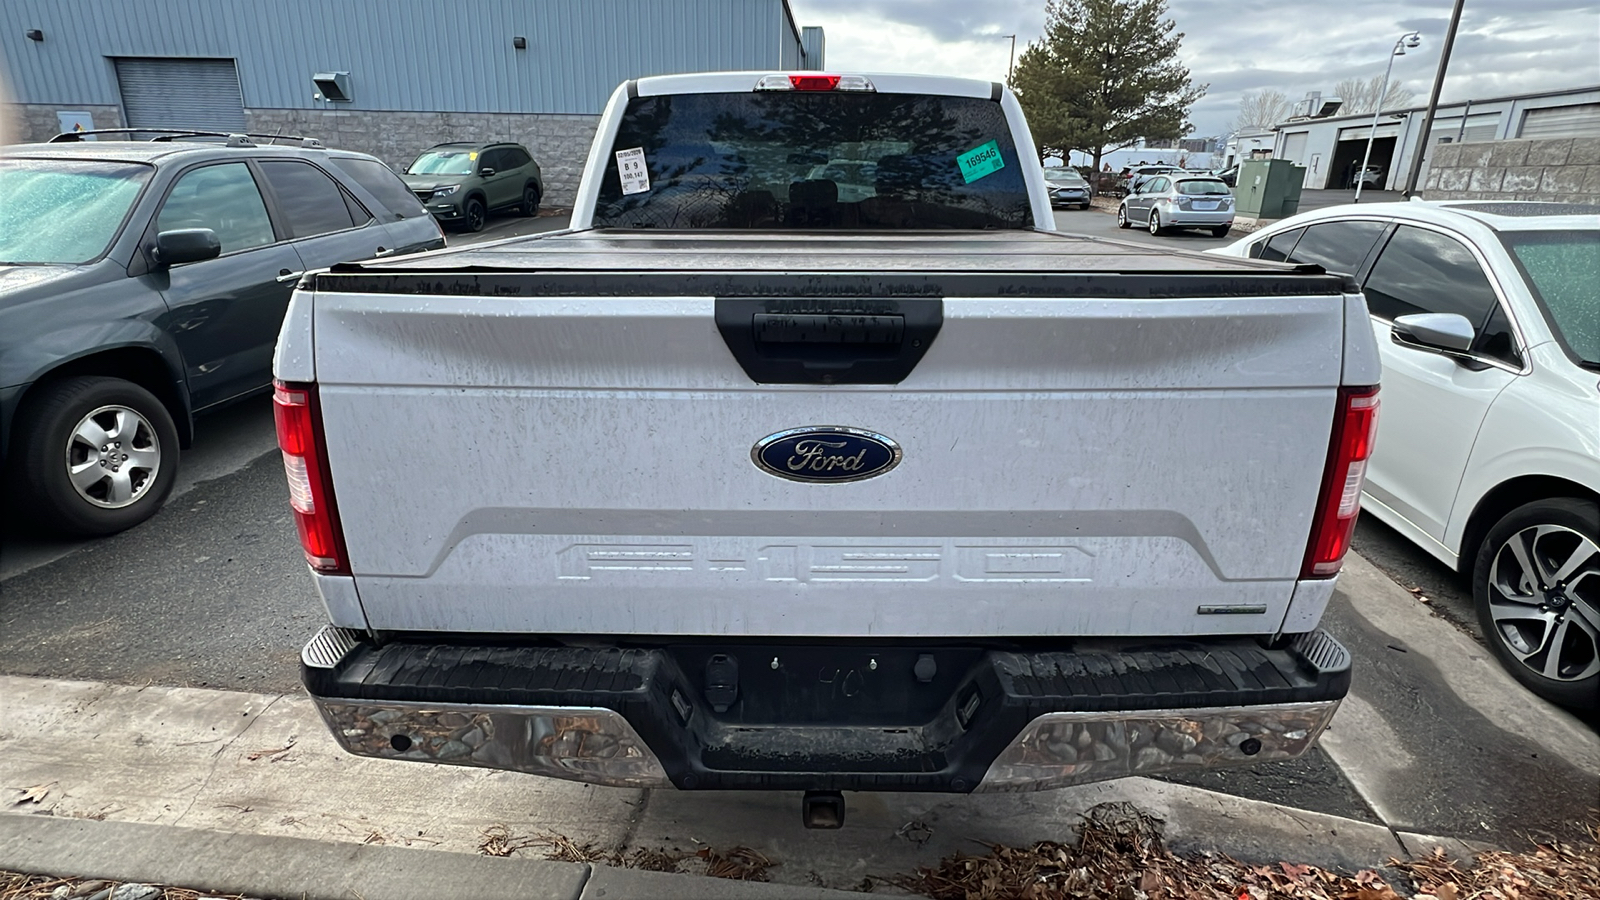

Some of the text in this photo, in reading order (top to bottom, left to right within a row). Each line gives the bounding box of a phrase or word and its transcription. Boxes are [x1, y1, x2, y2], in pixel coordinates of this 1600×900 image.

[633, 162, 638, 170] 9
[966, 147, 997, 168] 169546
[787, 439, 867, 471] Ford
[555, 543, 1097, 583] F-150
